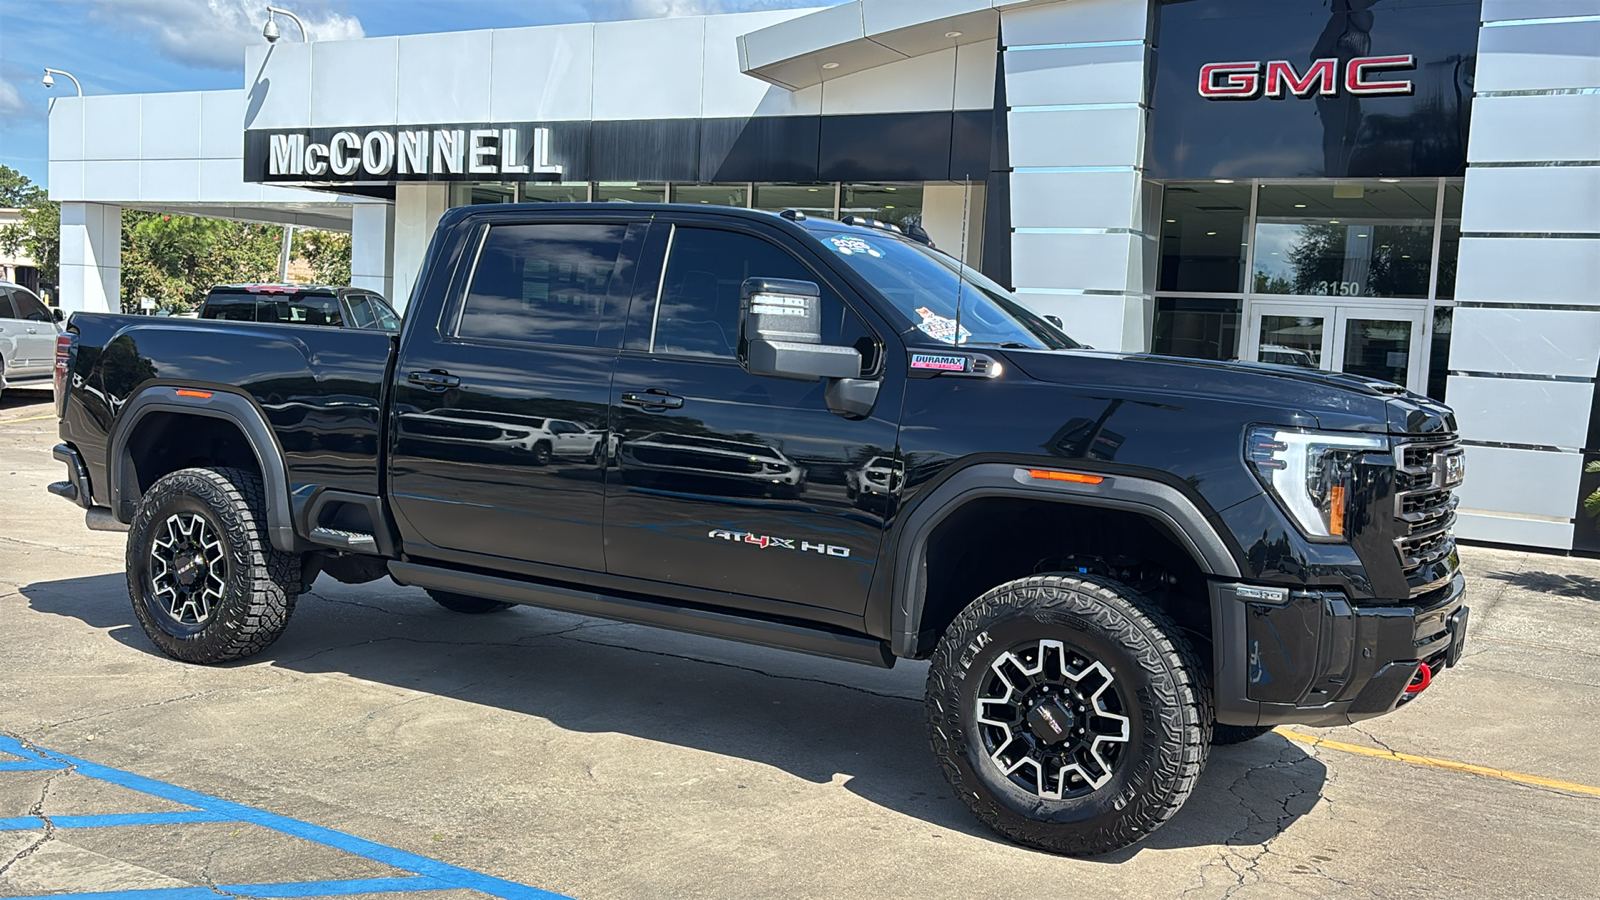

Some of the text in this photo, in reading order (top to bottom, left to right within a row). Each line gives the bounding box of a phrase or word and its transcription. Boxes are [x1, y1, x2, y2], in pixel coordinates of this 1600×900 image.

[1198, 54, 1413, 98] GMC
[269, 127, 562, 176] McCONNELL
[1318, 280, 1360, 297] 3150
[915, 355, 962, 365] DURAMAX
[708, 528, 850, 557] AT4X HD
